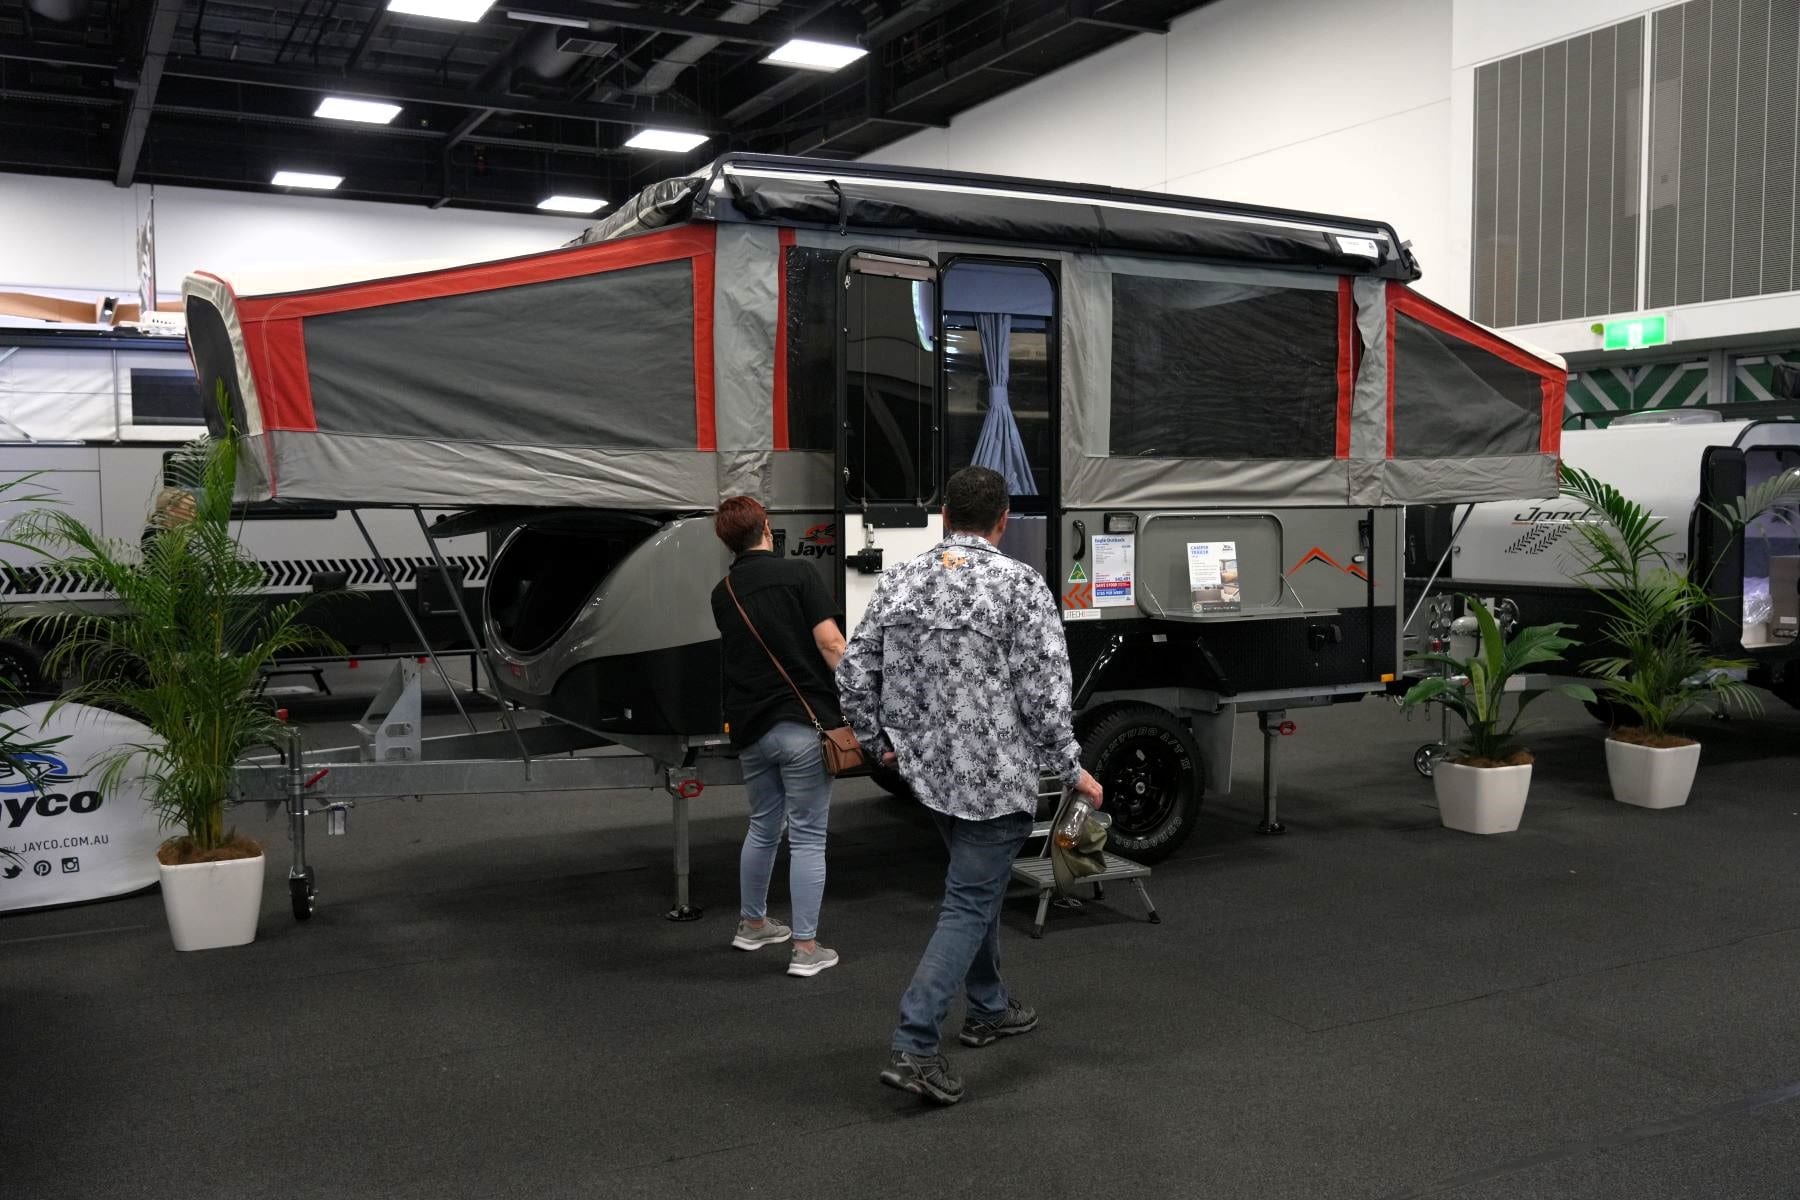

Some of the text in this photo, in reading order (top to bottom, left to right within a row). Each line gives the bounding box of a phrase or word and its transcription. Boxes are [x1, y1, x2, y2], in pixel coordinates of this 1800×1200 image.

[791, 541, 836, 559] Jayc
[0, 790, 103, 828] yco
[21, 834, 109, 853] JAYCO.COM.AU
